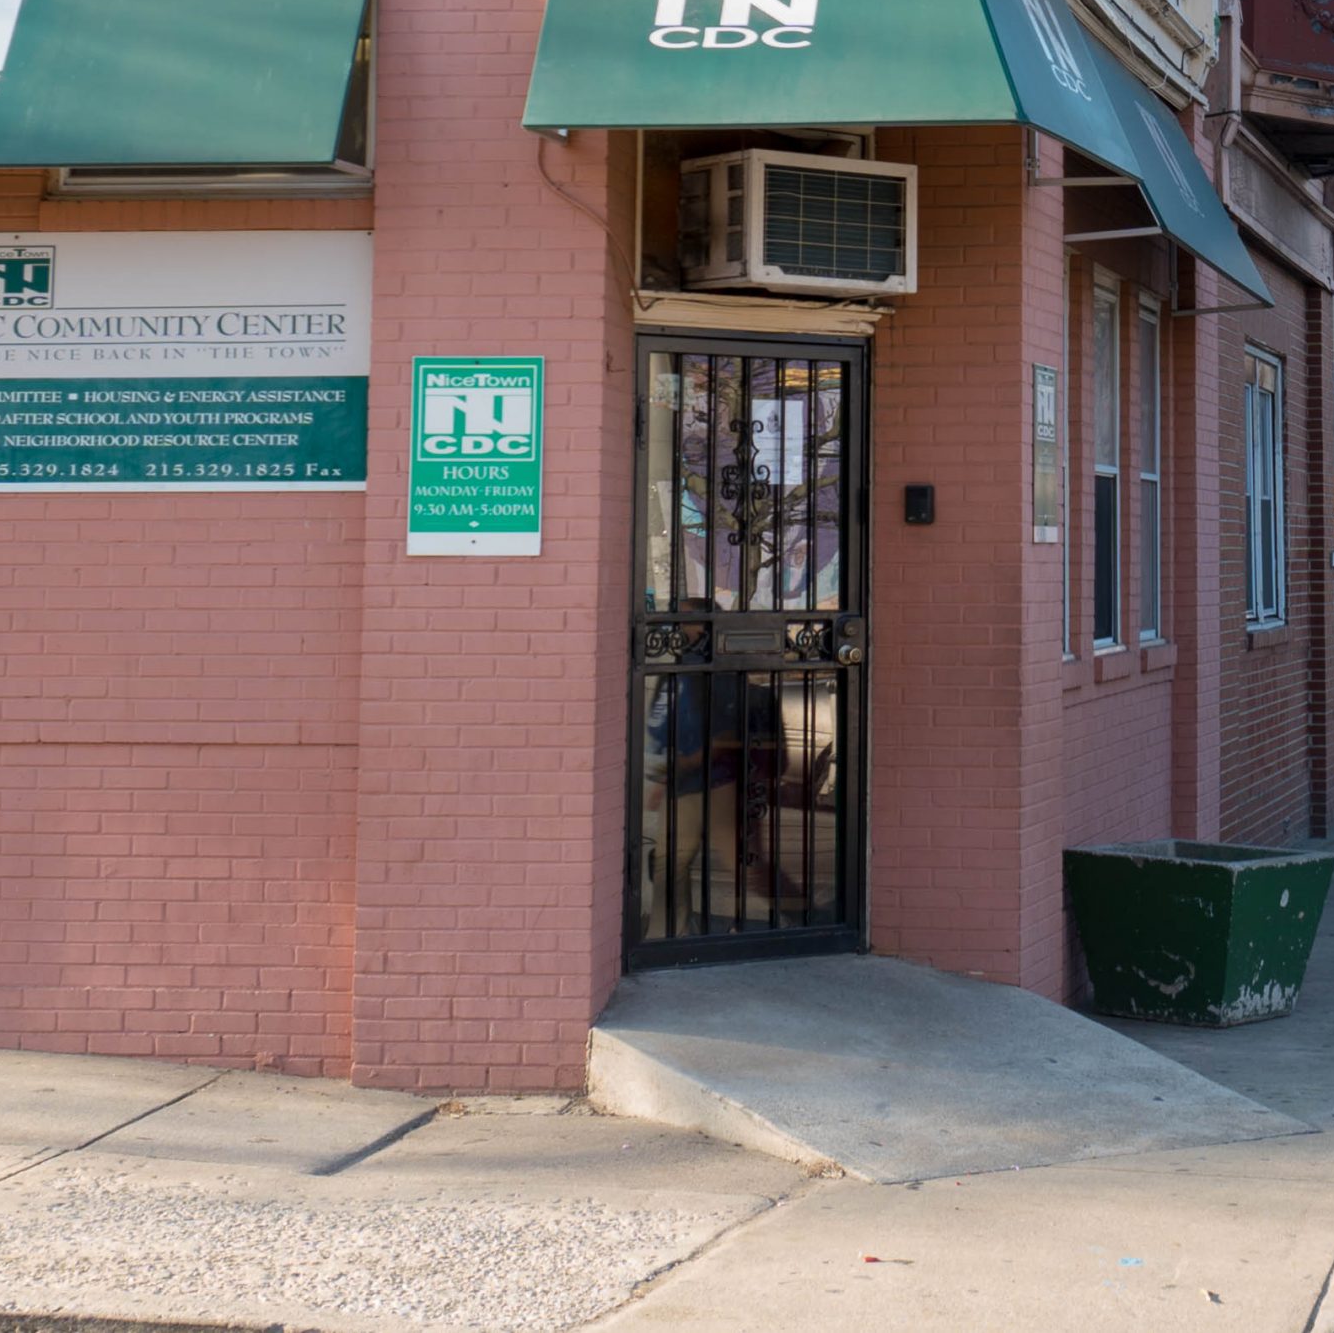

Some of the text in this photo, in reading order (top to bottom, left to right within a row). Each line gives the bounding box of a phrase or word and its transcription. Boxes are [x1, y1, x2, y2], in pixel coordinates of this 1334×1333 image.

[649, 26, 813, 48] CDC
[27, 348, 82, 362] NICE
[93, 347, 152, 361] BACK
[163, 347, 186, 360] IN
[426, 373, 531, 387] NiceTown
[84, 389, 346, 404] HOUSING & ENERGY ASSISTANCE
[1, 412, 314, 425] AFTER SCHOOL AND YOUTH PROGRAMS
[4, 434, 299, 447] NEIGHBORHOOD RESOURCE CENTER
[423, 435, 532, 455] CDC
[145, 463, 343, 478] 215.329.1825 Fax
[443, 466, 510, 480] HOURS
[414, 504, 445, 516] 9:30
